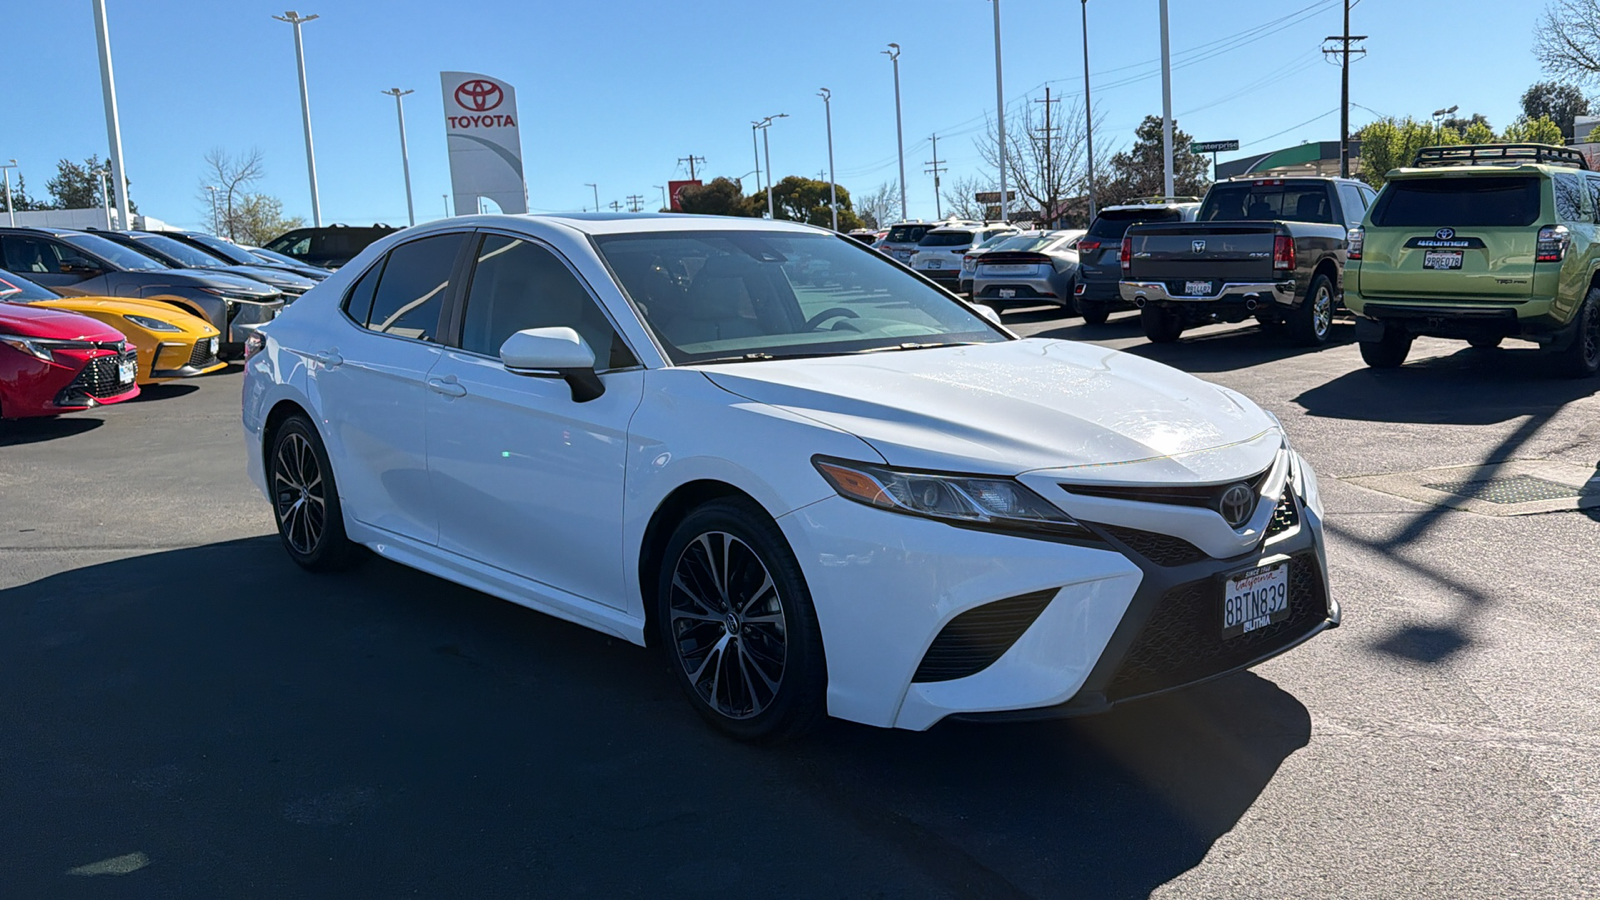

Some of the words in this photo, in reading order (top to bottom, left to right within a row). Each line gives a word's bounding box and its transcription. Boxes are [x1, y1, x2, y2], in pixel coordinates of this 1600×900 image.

[447, 114, 516, 129] TOYOTA
[1194, 141, 1238, 151] enterprise
[1226, 583, 1286, 627] 8BTN839
